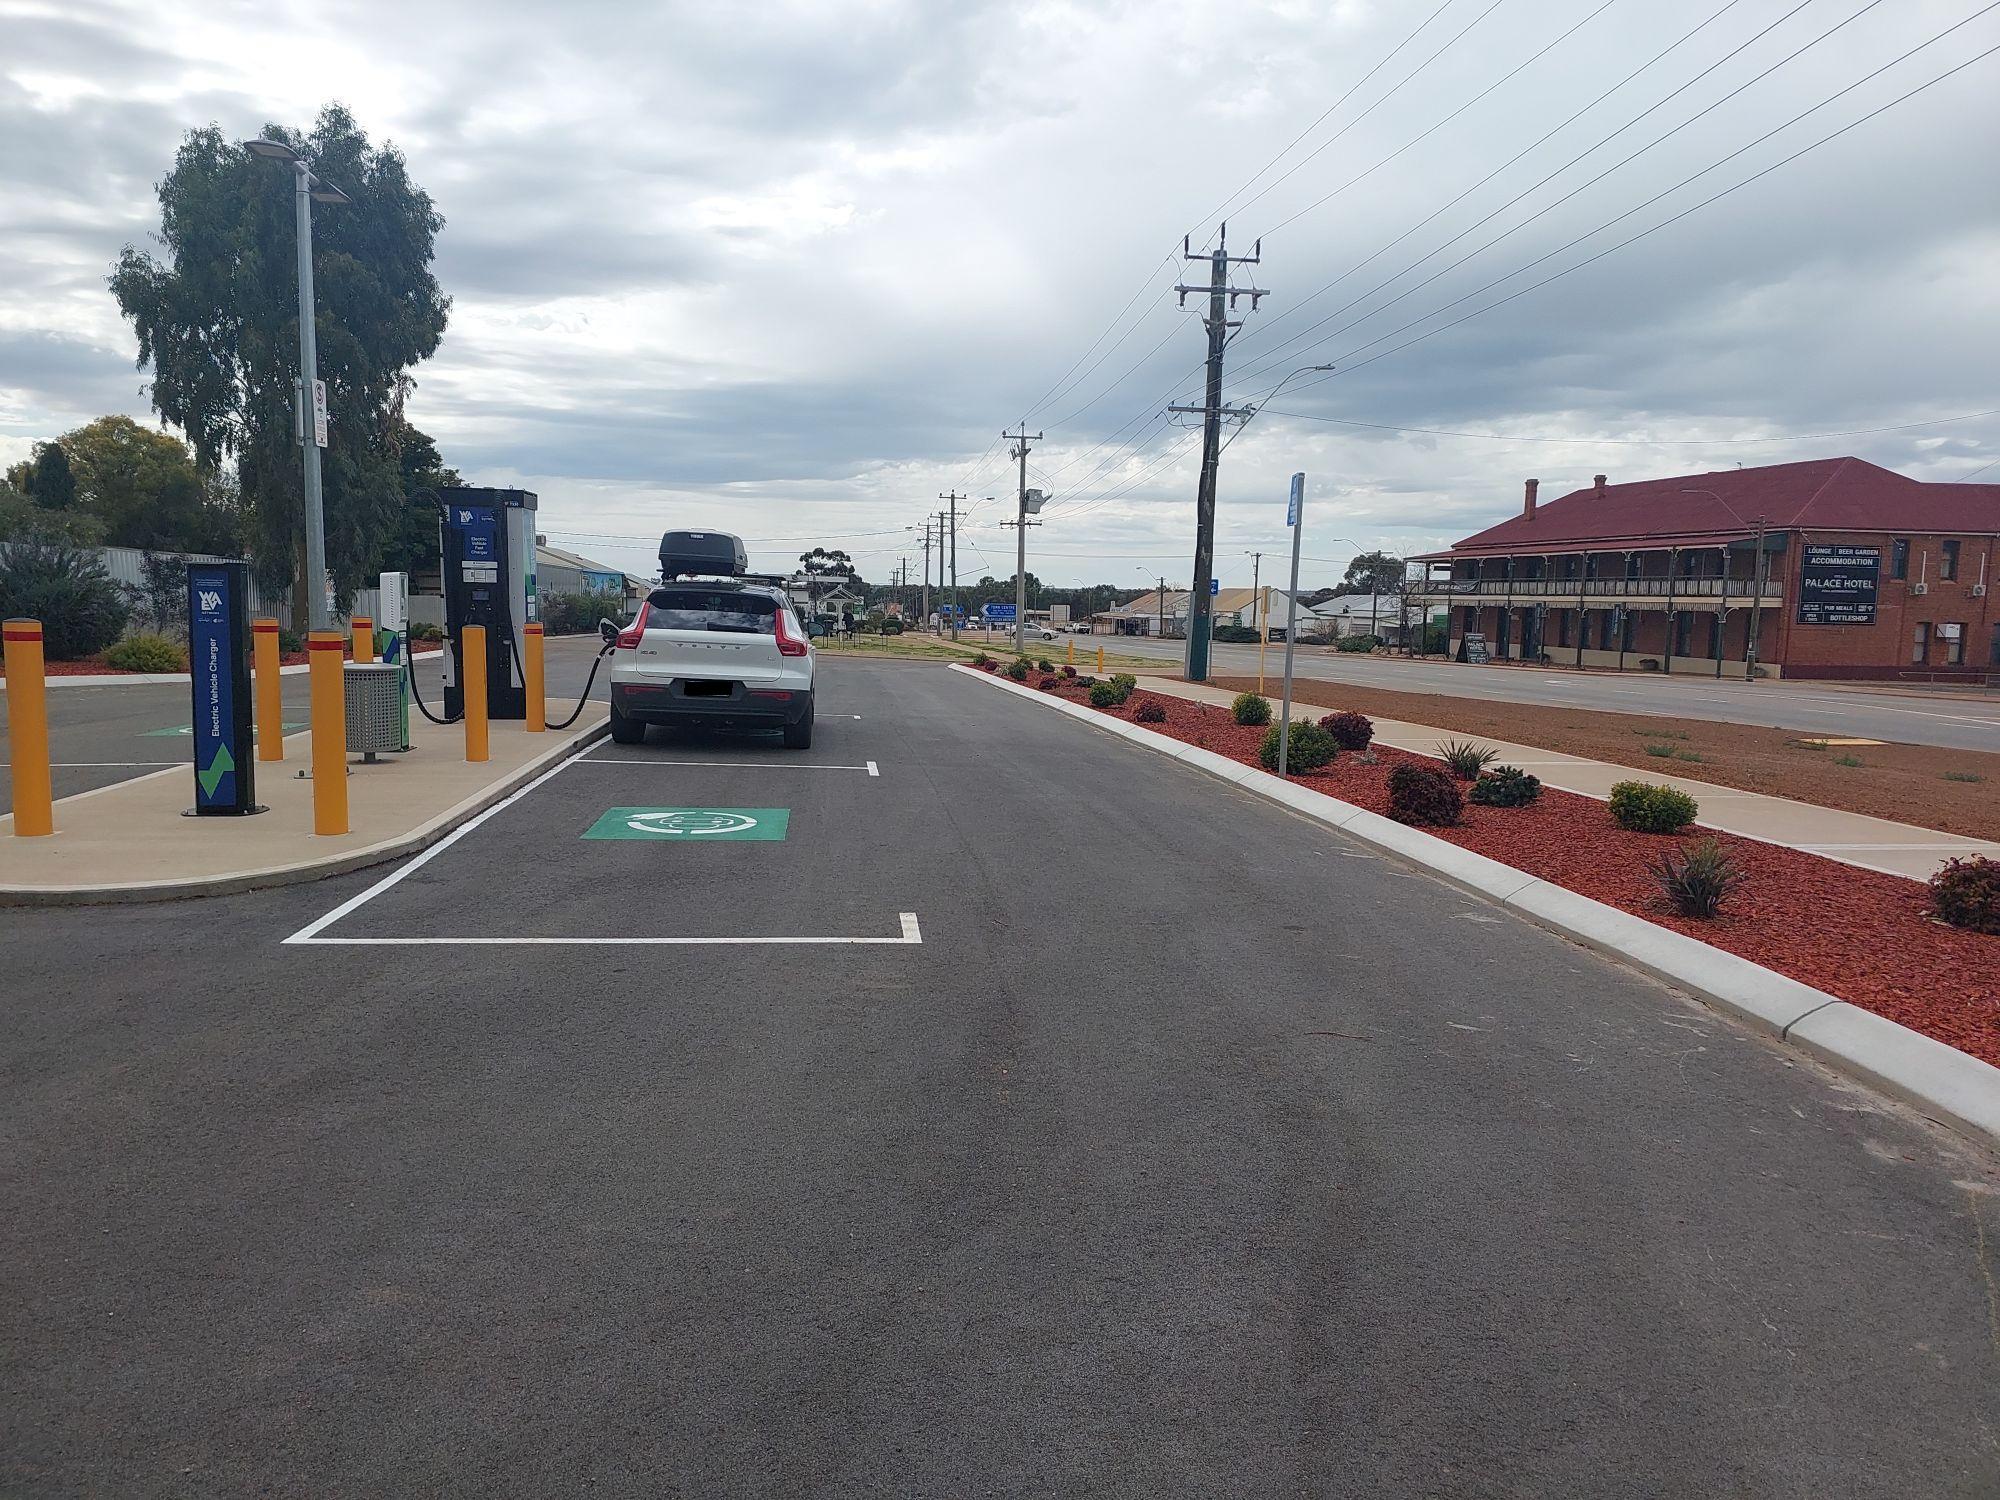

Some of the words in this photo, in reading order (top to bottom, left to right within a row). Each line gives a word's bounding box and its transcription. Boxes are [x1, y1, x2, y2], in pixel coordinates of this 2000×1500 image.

[1811, 557, 1874, 566] ACCOMMODATION
[1805, 578, 1842, 588] PALACE
[1844, 579, 1875, 589] HOTEL
[1830, 614, 1869, 622] BOTTLESHOP
[209, 638, 219, 672] Charger
[210, 674, 219, 704] Vehicle
[211, 705, 220, 737] Electric
